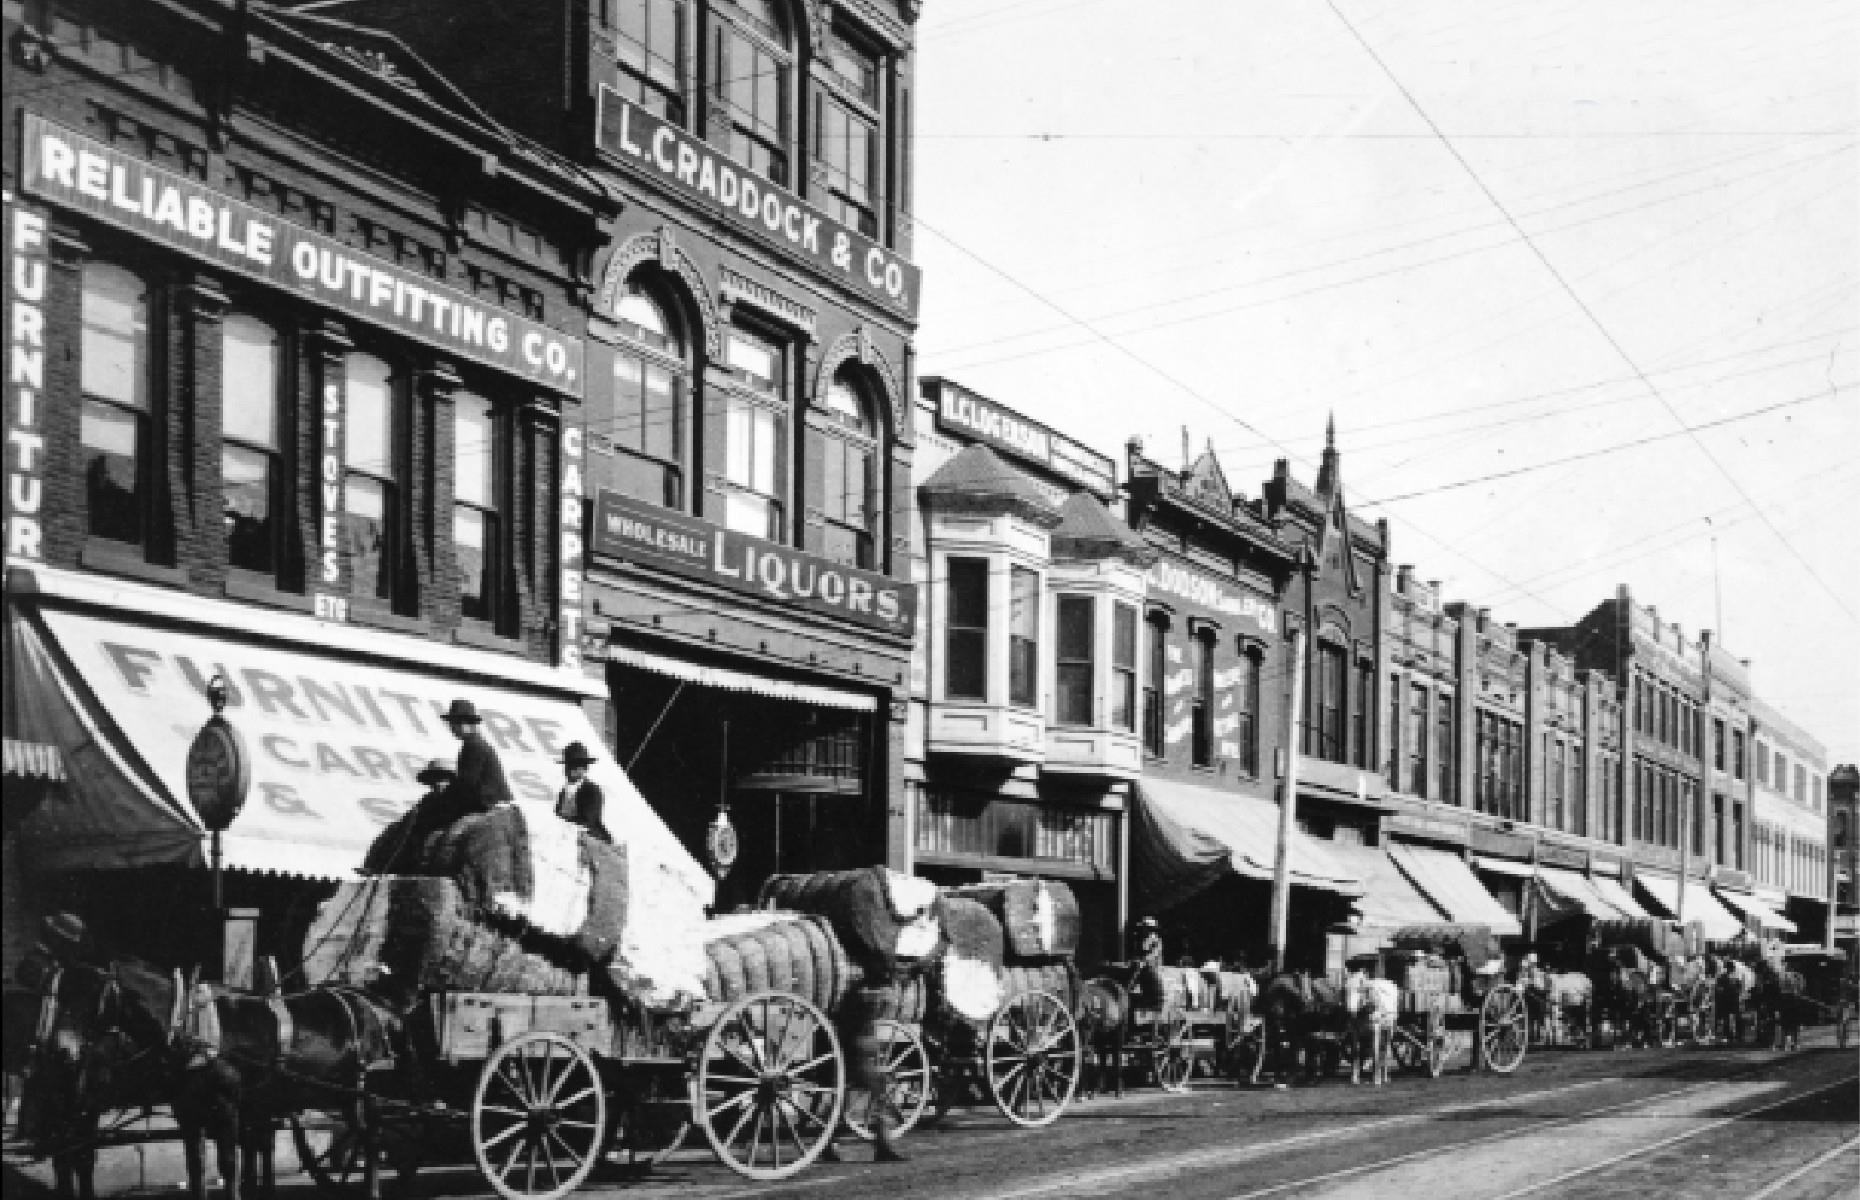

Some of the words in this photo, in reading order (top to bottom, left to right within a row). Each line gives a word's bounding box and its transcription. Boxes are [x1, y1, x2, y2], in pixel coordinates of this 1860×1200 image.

[42, 135, 273, 266] RELIABLE
[292, 241, 509, 353] OUTFITTING
[521, 333, 576, 381] CO.
[832, 231, 851, 271] &
[8, 206, 47, 558] FURNITUR
[323, 384, 339, 582] STOVES
[561, 427, 583, 669] CARPETS
[714, 530, 908, 624] LIQUORS.
[258, 733, 558, 802] CARPS
